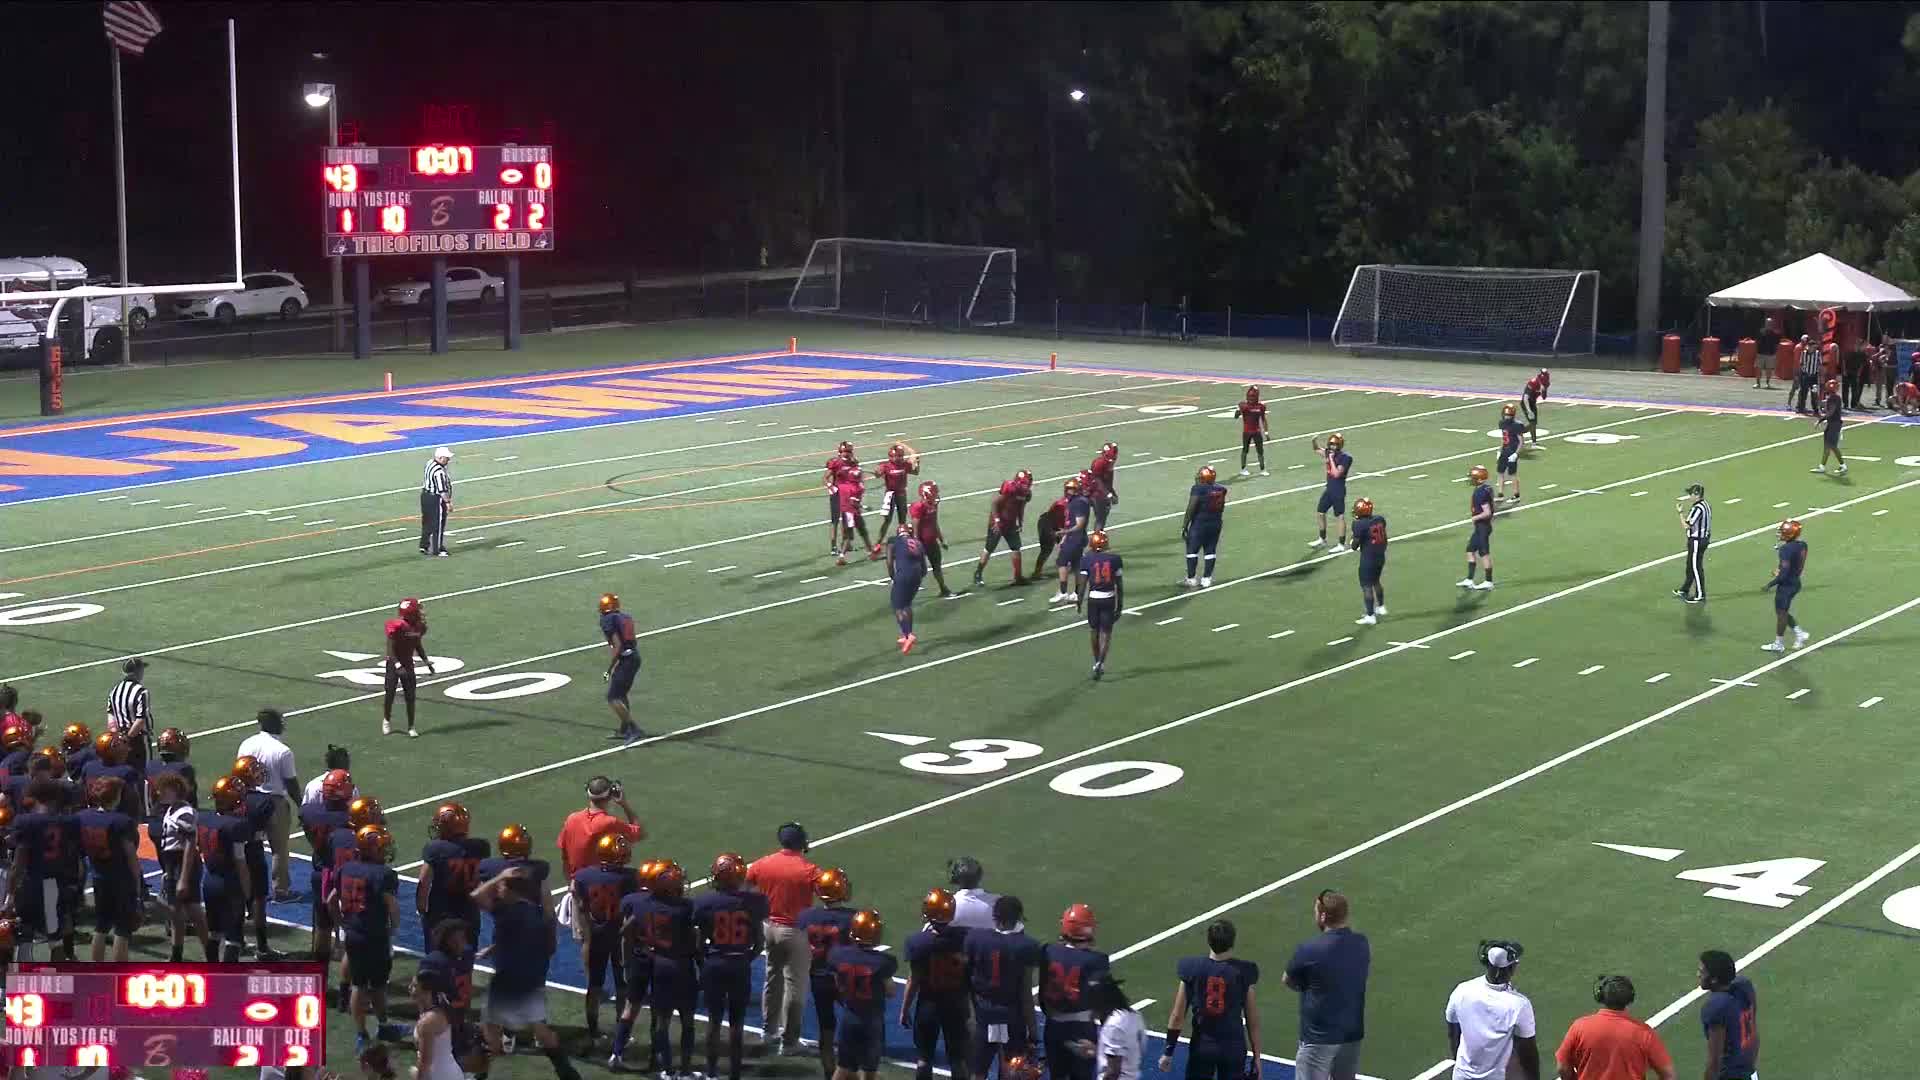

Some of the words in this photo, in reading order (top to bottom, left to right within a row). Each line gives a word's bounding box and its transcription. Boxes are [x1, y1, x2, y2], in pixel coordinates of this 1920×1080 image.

[416, 146, 472, 175] 10:07
[502, 148, 548, 162] GUESTS
[325, 164, 357, 192] 43
[329, 192, 358, 207] DOWN
[479, 190, 499, 205] BALL
[382, 205, 406, 233] 10
[494, 203, 511, 231] 2
[528, 203, 545, 230] 2
[352, 234, 469, 254] THEOFILOS
[475, 232, 531, 251] FIELD
